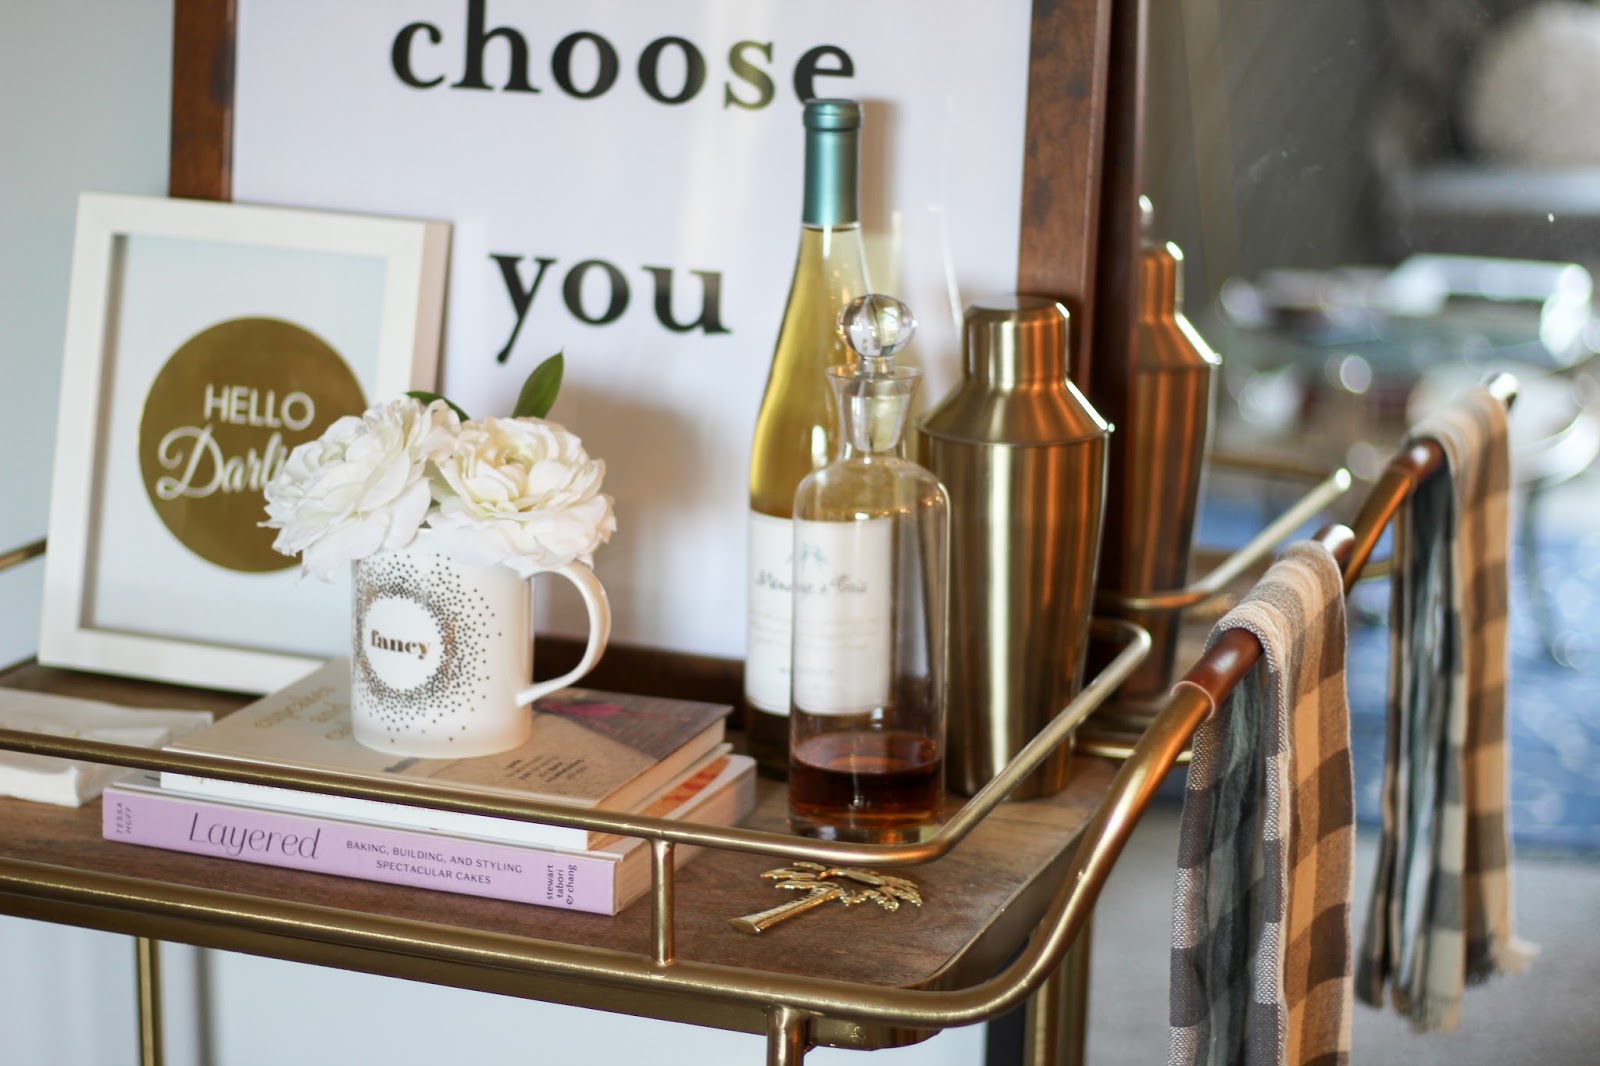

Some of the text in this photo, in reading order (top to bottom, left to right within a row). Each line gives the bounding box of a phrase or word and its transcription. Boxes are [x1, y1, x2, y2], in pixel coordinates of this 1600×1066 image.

[391, 0, 856, 111] choose
[489, 252, 733, 364] you
[204, 384, 315, 431] HELLO
[157, 423, 288, 500] Darli
[371, 629, 431, 660] fancy
[189, 811, 322, 860] Layered
[346, 840, 523, 874] BAKING, BUILDING, AND STYLING
[376, 859, 492, 885] SPECTACULAR CAKES
[546, 864, 554, 900] stewart
[555, 869, 564, 898] tabori
[566, 864, 577, 893] chang
